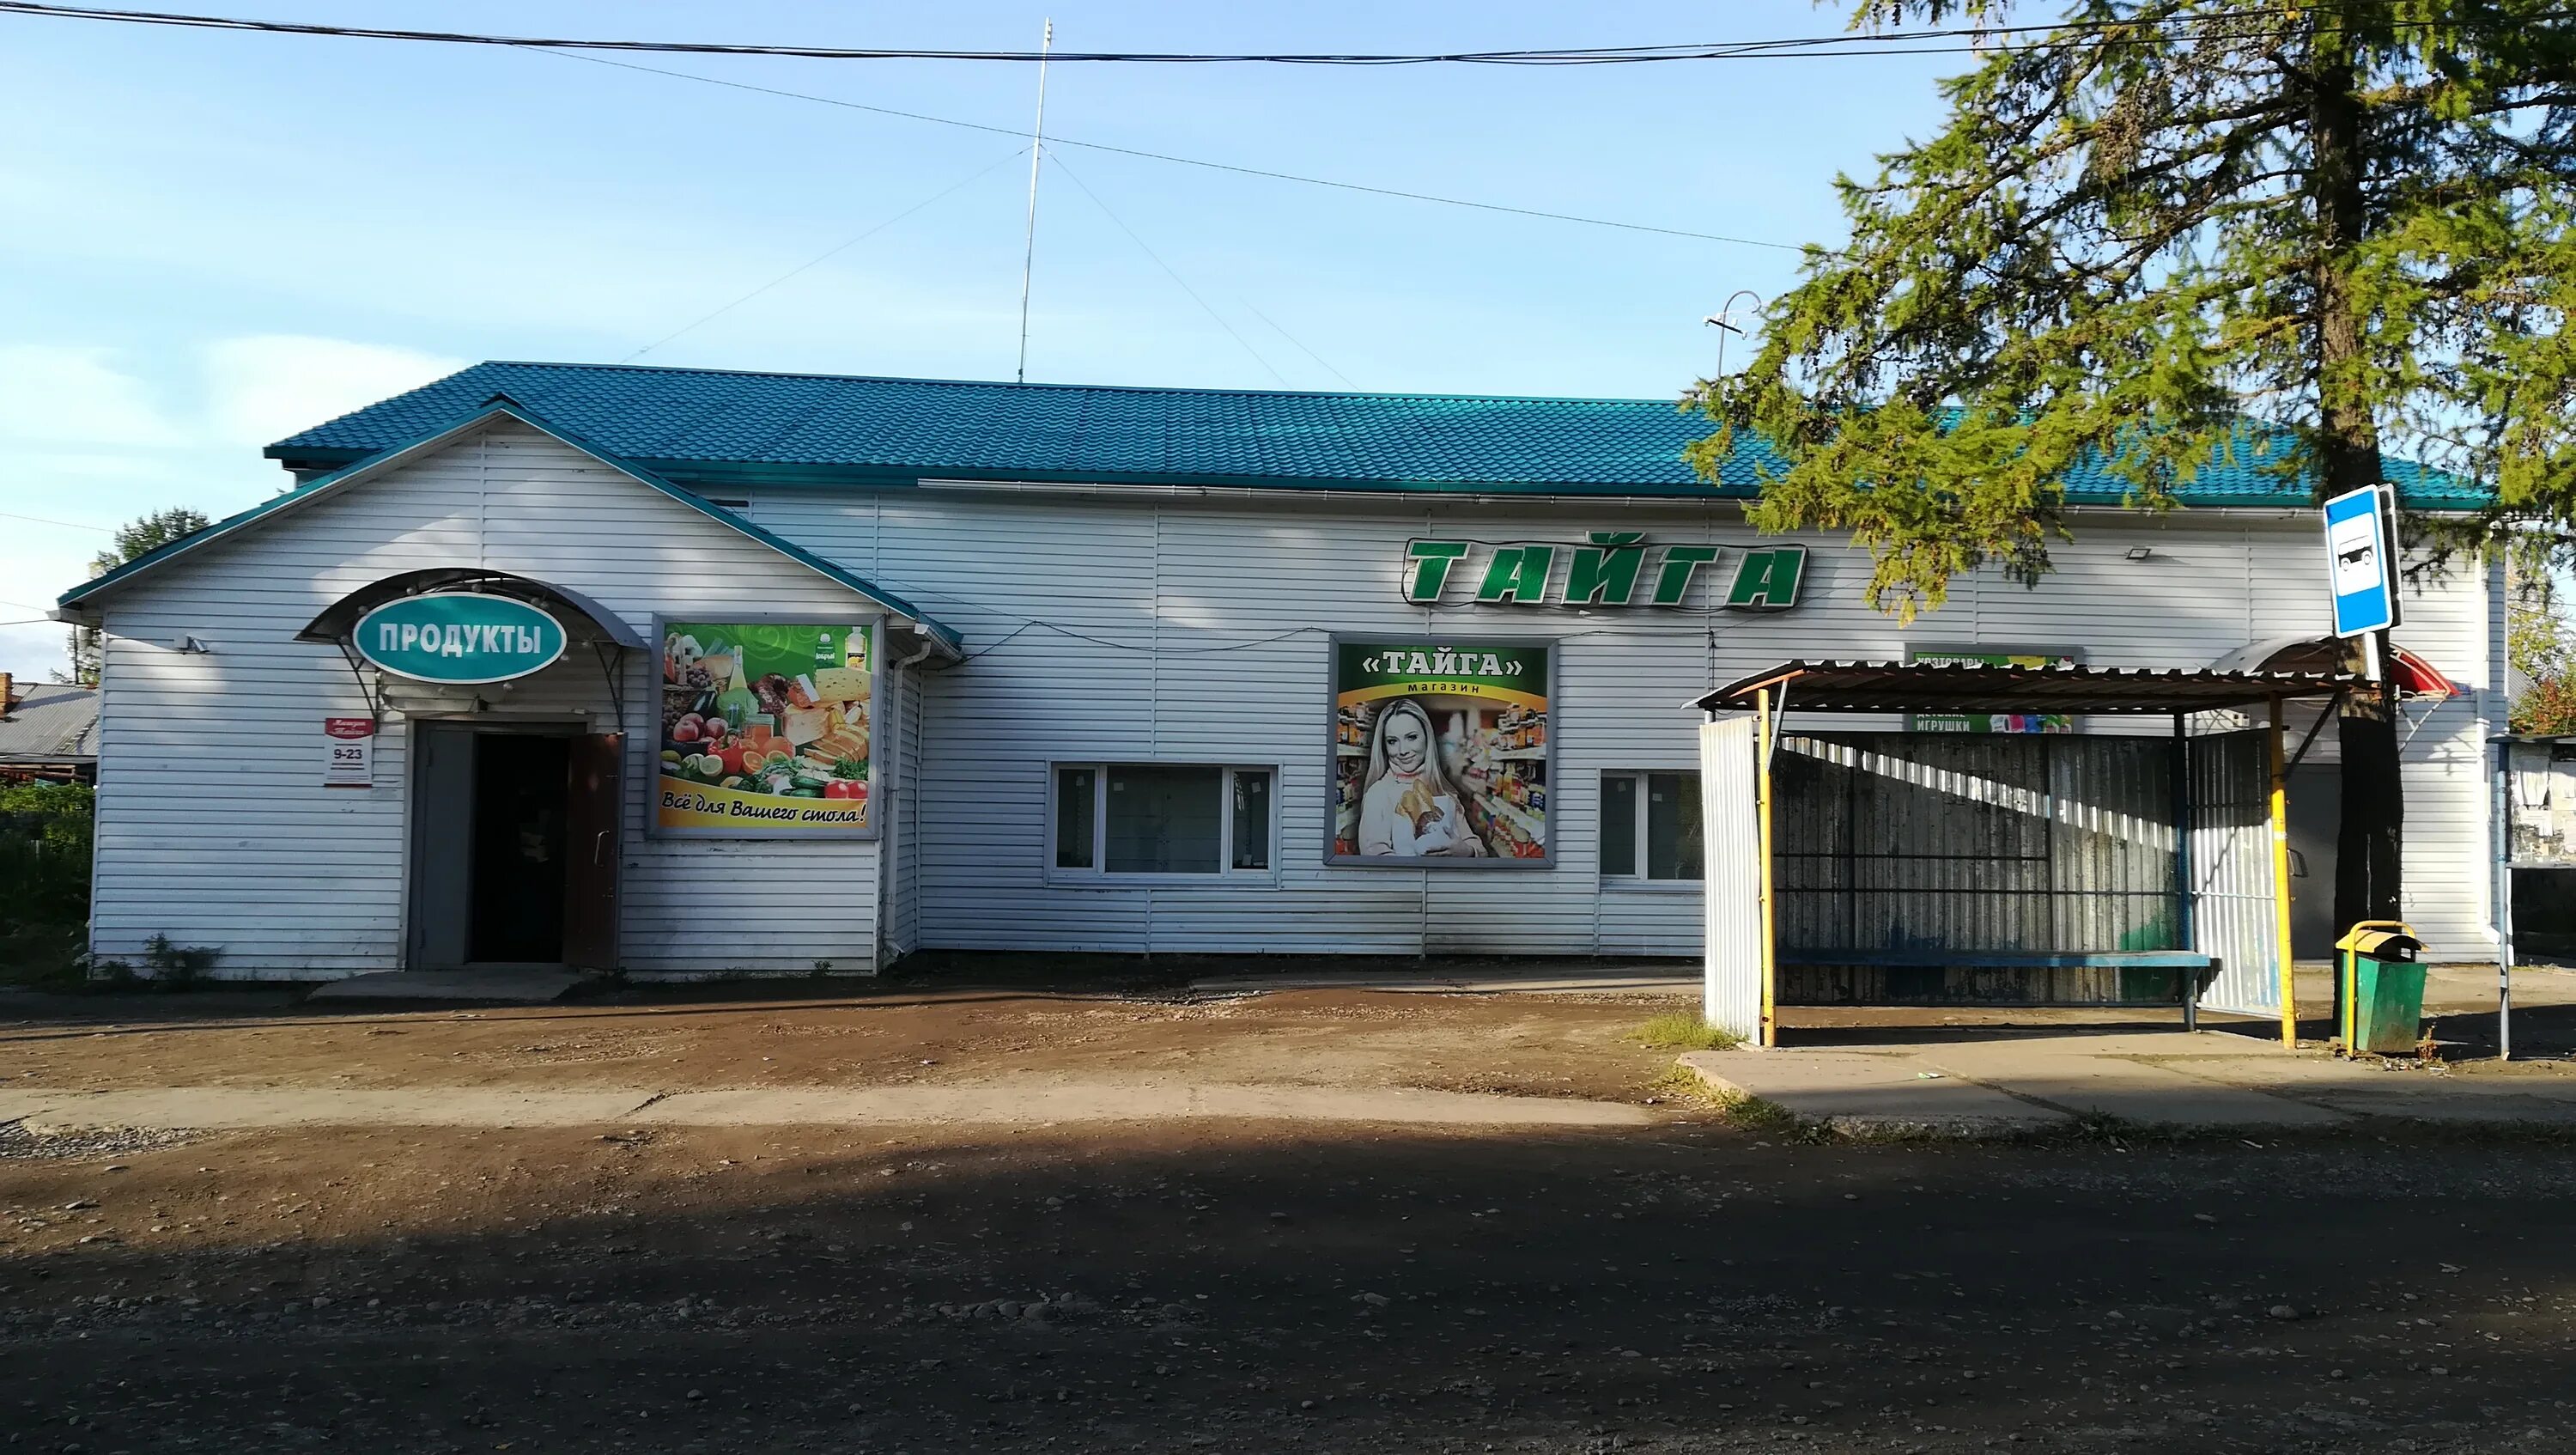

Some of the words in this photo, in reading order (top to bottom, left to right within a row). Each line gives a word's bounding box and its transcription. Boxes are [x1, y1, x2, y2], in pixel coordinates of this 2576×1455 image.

[1406, 532, 1807, 606] ТАЙГА
[379, 623, 542, 658] ПРОДУКТЫ
[1363, 646, 1523, 676] «ТАЙГА»
[1407, 682, 1479, 693] магазин
[1917, 720, 1971, 732] ИГРУШКИ
[333, 748, 363, 759] 9-23
[661, 792, 691, 808] Всё
[695, 794, 725, 813] для
[730, 801, 799, 822] Вашего
[801, 803, 866, 823] стола!
